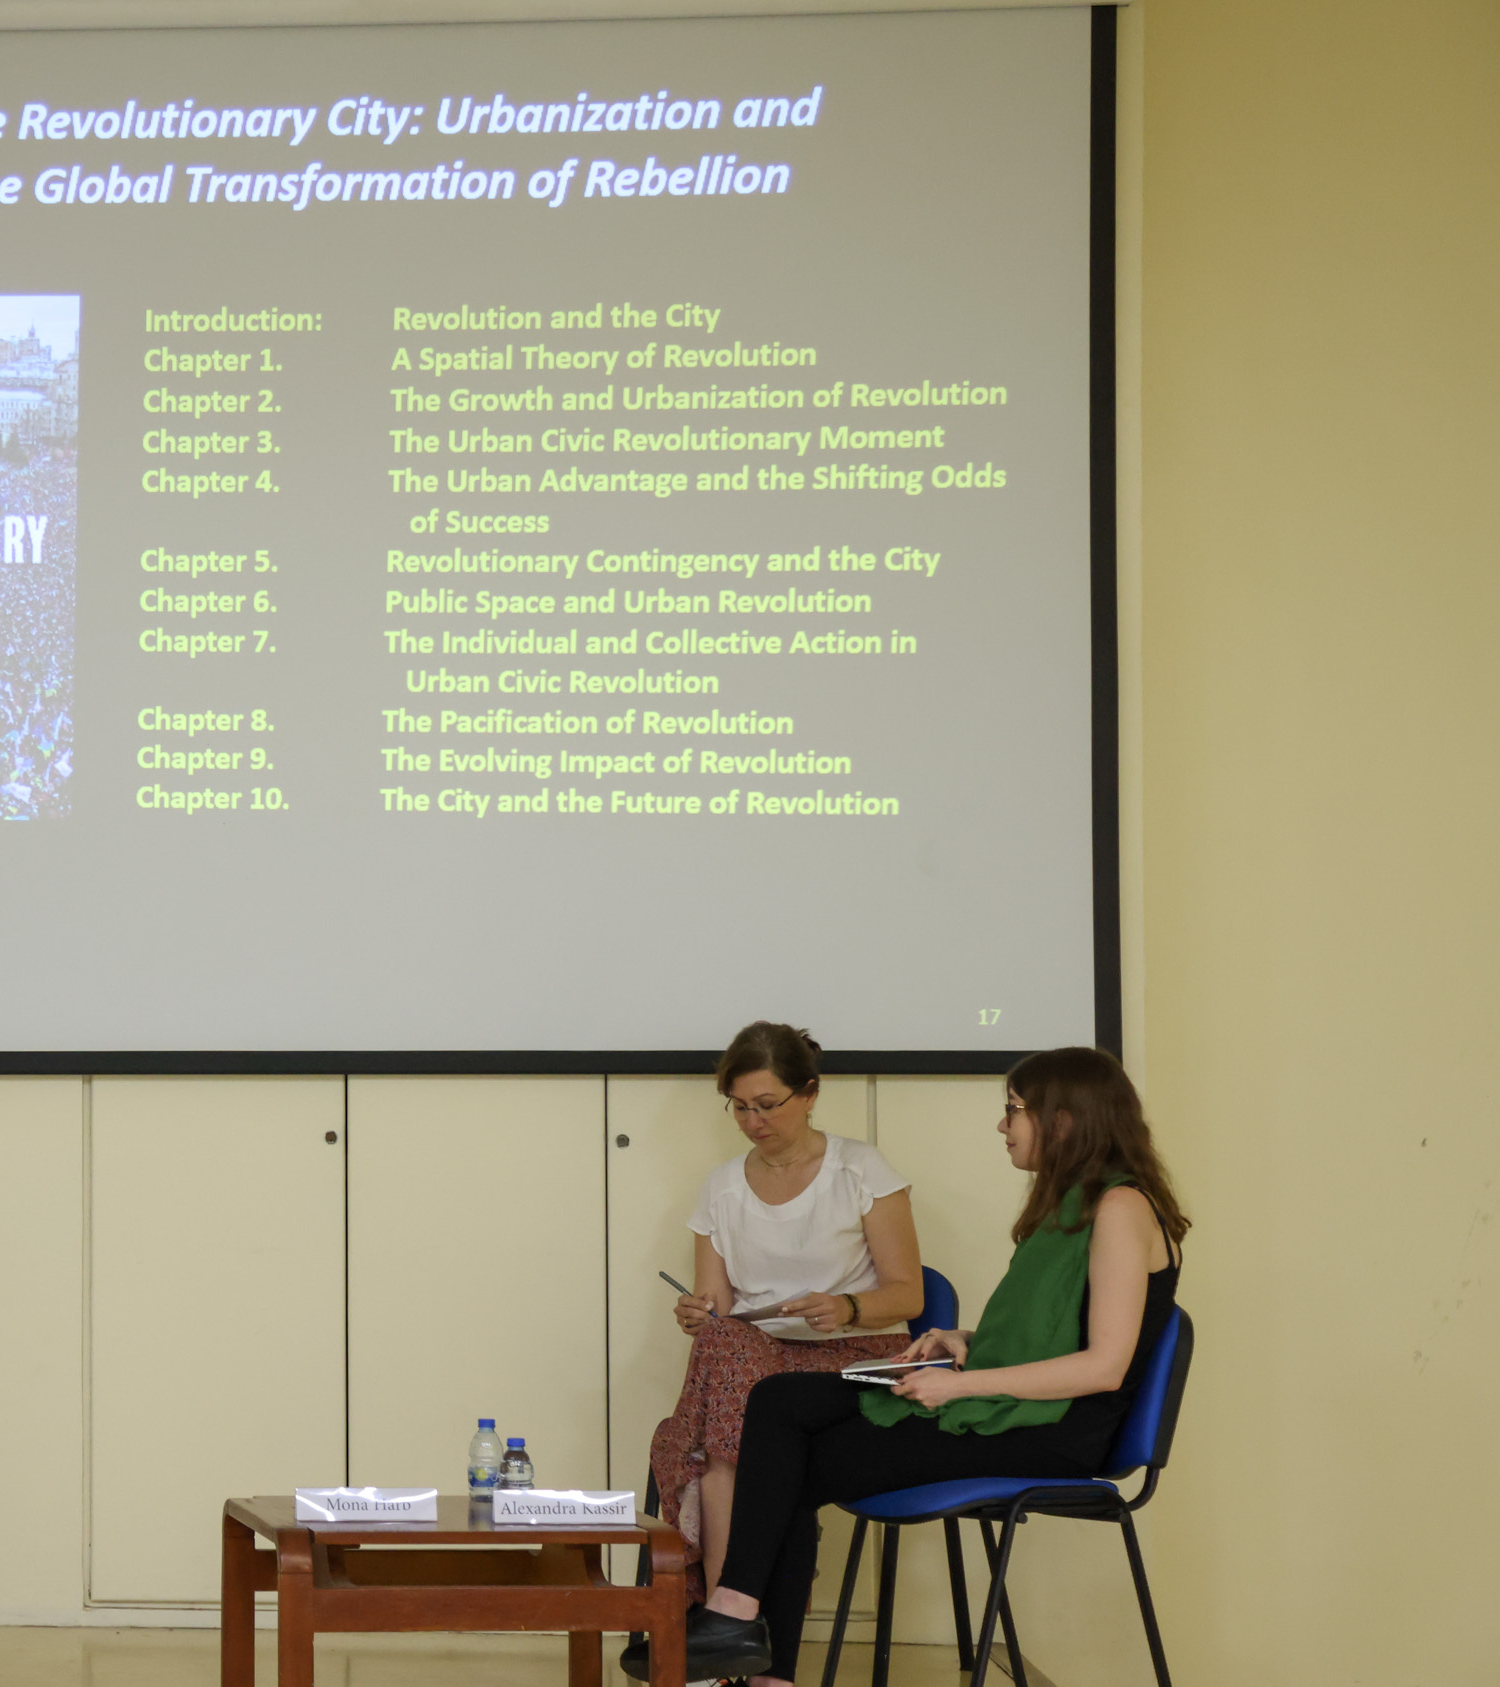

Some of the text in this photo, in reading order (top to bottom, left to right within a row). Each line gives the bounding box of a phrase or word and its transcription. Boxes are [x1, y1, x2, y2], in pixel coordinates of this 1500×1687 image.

[18, 98, 319, 146] Revolutionary
[327, 95, 425, 145] City:
[437, 90, 722, 134] Urbanization
[733, 85, 823, 128] and
[34, 162, 176, 204] Global
[185, 159, 517, 211] Transformation
[528, 157, 580, 208] of
[584, 154, 791, 197] Rebellion
[146, 302, 721, 333] Introduction: Revolution and the City
[145, 341, 816, 377] Chapter 1. A Spatial Theory of Revolution
[144, 380, 1007, 418] Chapter 2. The Growth and Urbanization of Revolution
[143, 426, 945, 460] Chapter 3. The Urban Civic Revolutionary Moment
[142, 462, 1006, 499] Chapter 4. The Urban Advantage and the Shifting Odds
[410, 508, 550, 533] of Success
[141, 546, 940, 579] Chapter 5. Revolutionary Contingency and the City
[140, 587, 871, 619] Chapter 6. Public Space and Urban Revolution
[139, 628, 916, 658] Chapter 7. The Individual and Collective Action in
[407, 668, 719, 693] Urban Civic Revolution
[138, 706, 793, 736] Chapter 8. The Pacification of Revolution
[138, 744, 851, 779] Chapter 9. The Evolving Impact of Revolution
[136, 784, 899, 818] Chapter 10. The City and the Future of Revolution
[980, 1008, 1001, 1025] 17
[326, 1498, 368, 1511] Mona
[501, 1501, 627, 1515] Alexandra Kassir
